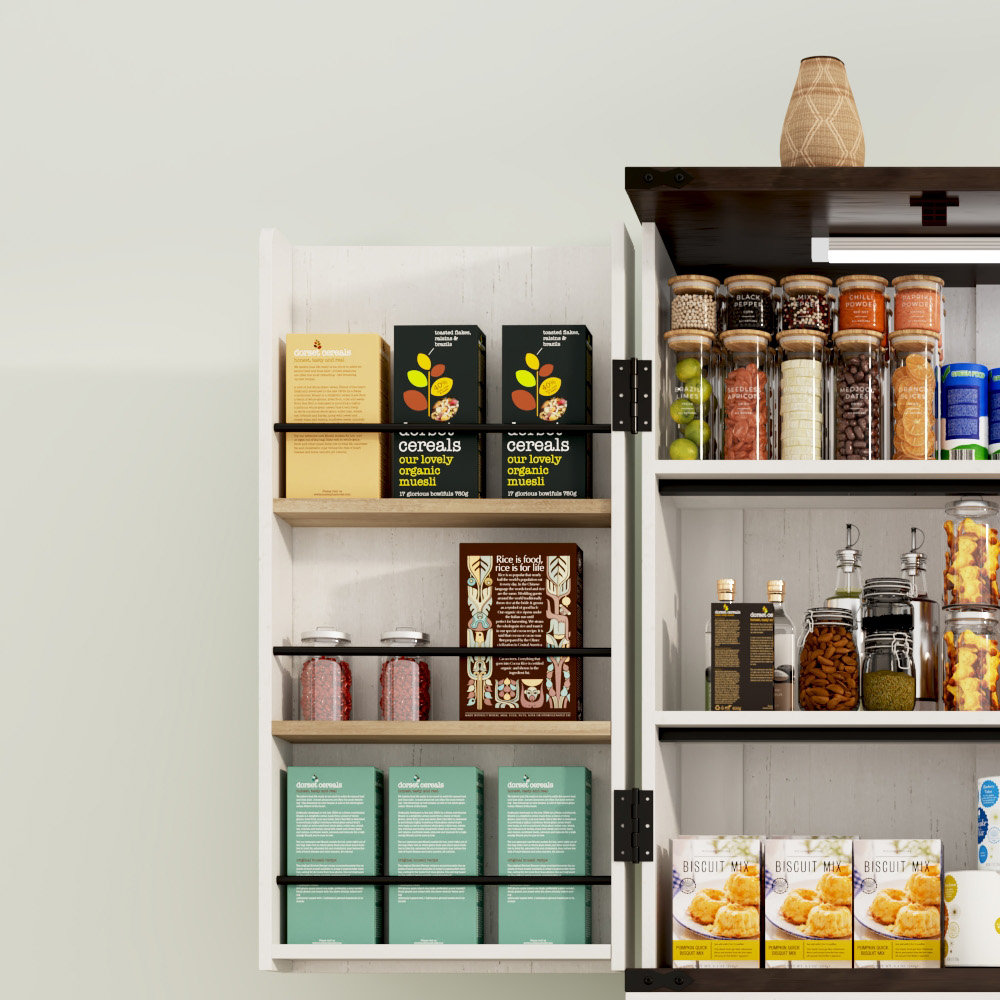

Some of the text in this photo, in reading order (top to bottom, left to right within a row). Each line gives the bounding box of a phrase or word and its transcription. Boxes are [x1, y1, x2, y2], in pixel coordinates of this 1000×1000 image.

[398, 437, 462, 452] cereals
[506, 437, 570, 452] cereals
[399, 454, 455, 466] our lovely
[507, 454, 562, 466] our lovely
[398, 465, 441, 477] organic
[507, 465, 549, 477] organic
[398, 477, 437, 487] muesli
[507, 477, 545, 486] muesli
[496, 554, 544, 565] Rice is food,
[495, 562, 545, 572] rice is for life
[296, 781, 343, 789] dorset cereals
[397, 781, 445, 789] dorset cereals
[507, 781, 554, 789] dorset cereals
[683, 860, 750, 873] BISCUIT MIX
[775, 860, 842, 873] BISCUIT MIX
[864, 860, 931, 873] BISCUIT MIX
